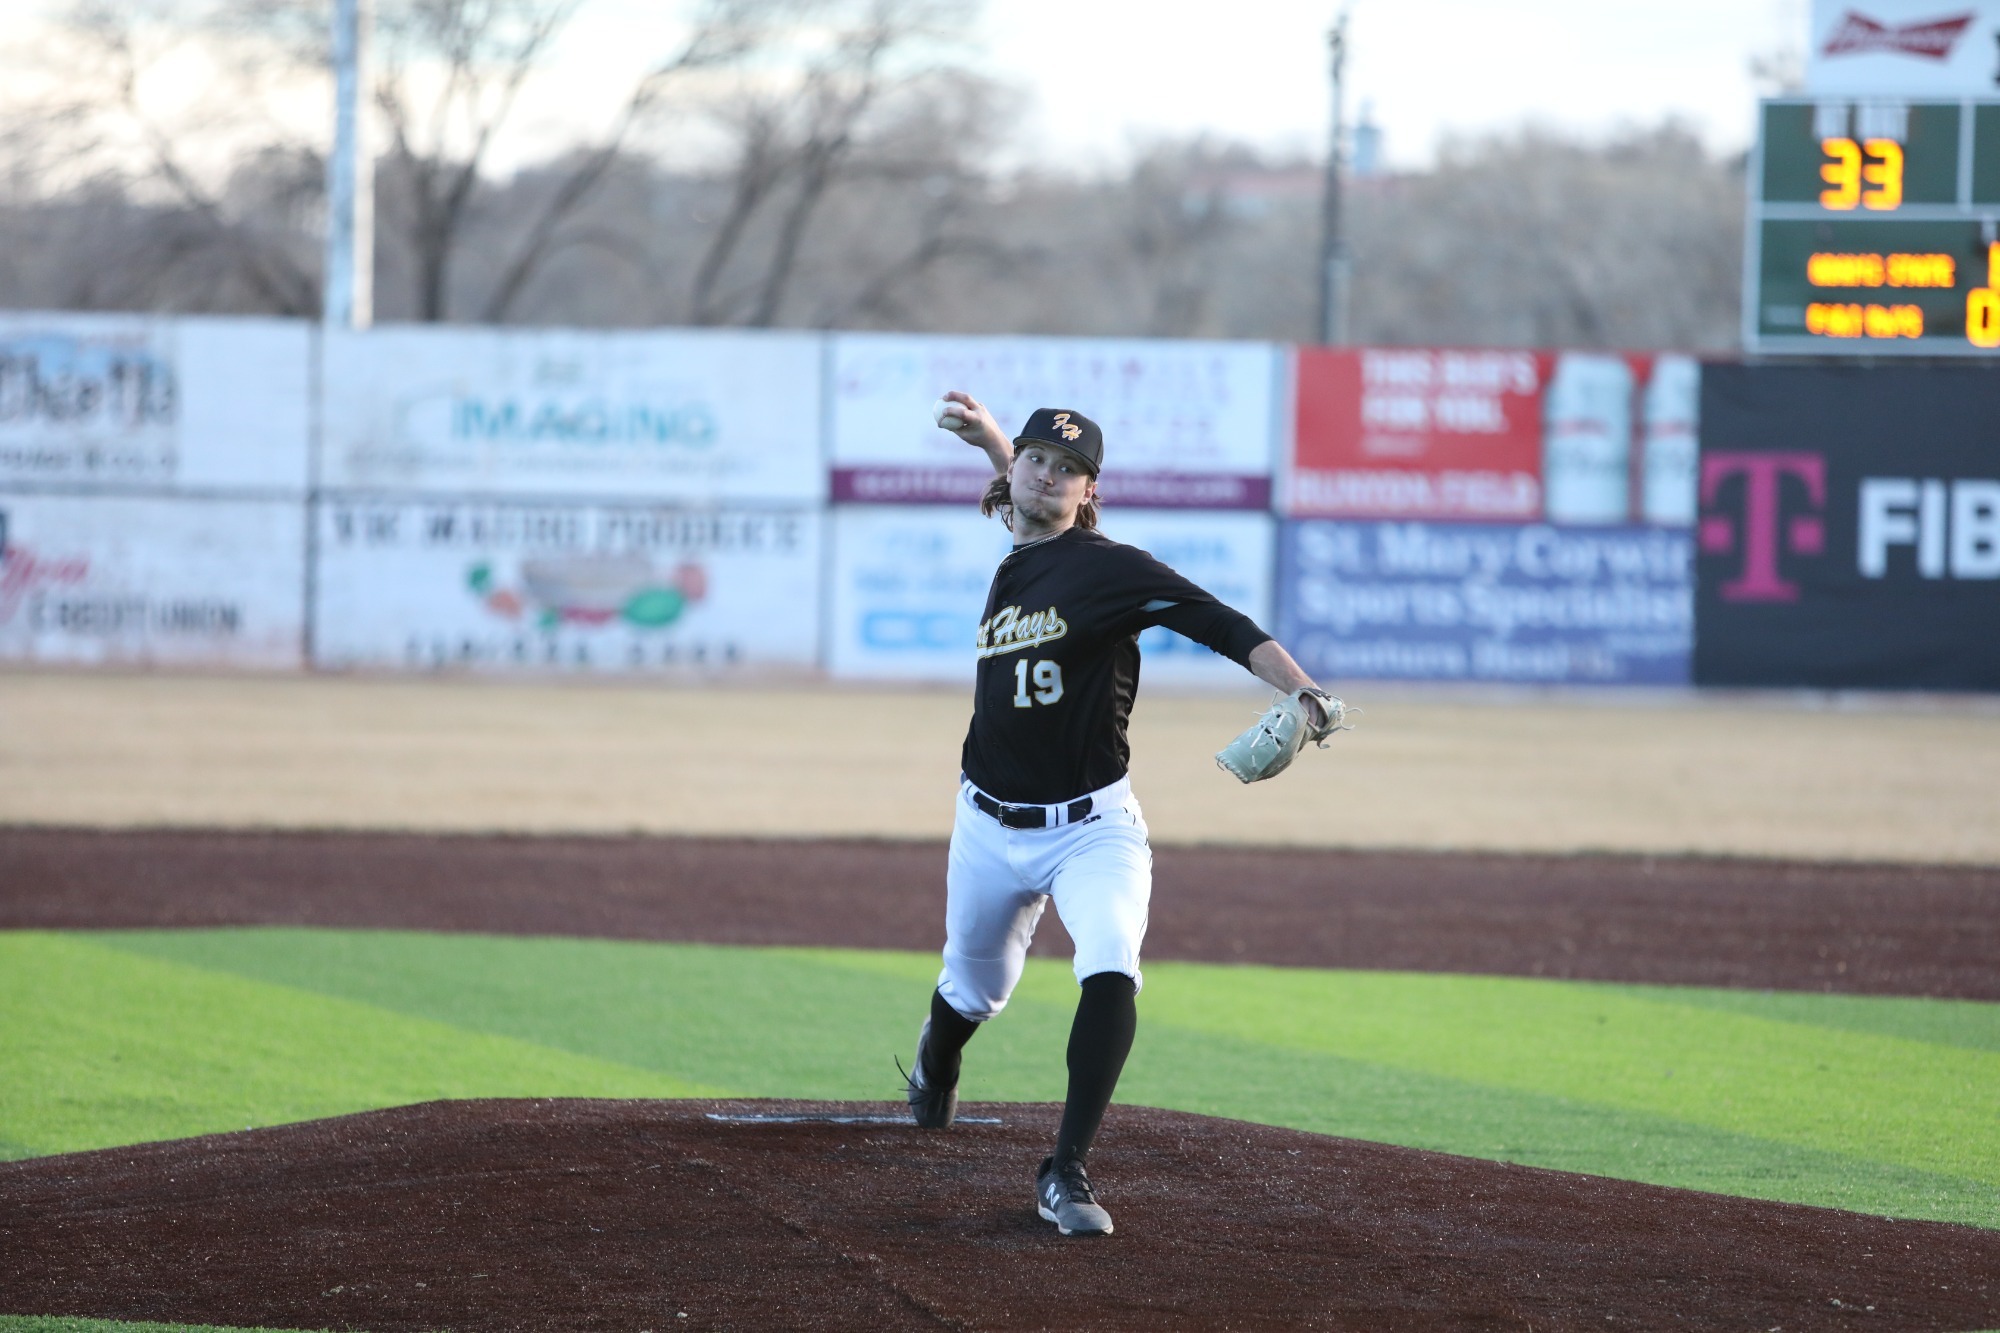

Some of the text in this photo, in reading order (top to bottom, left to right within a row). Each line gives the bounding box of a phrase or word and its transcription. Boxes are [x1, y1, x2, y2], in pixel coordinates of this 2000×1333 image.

[1820, 137, 1904, 210] 33
[1361, 350, 1433, 386] THIS
[450, 398, 716, 447] IMAGING
[1361, 395, 1427, 430] FOR
[1440, 471, 1539, 513] FIELD
[1300, 525, 1362, 573] St.
[1377, 525, 1506, 580] Mary
[1857, 477, 2000, 579] FIB
[992, 605, 1068, 649] Hays
[1300, 574, 1462, 635] Sports
[1013, 658, 1064, 708] 19
